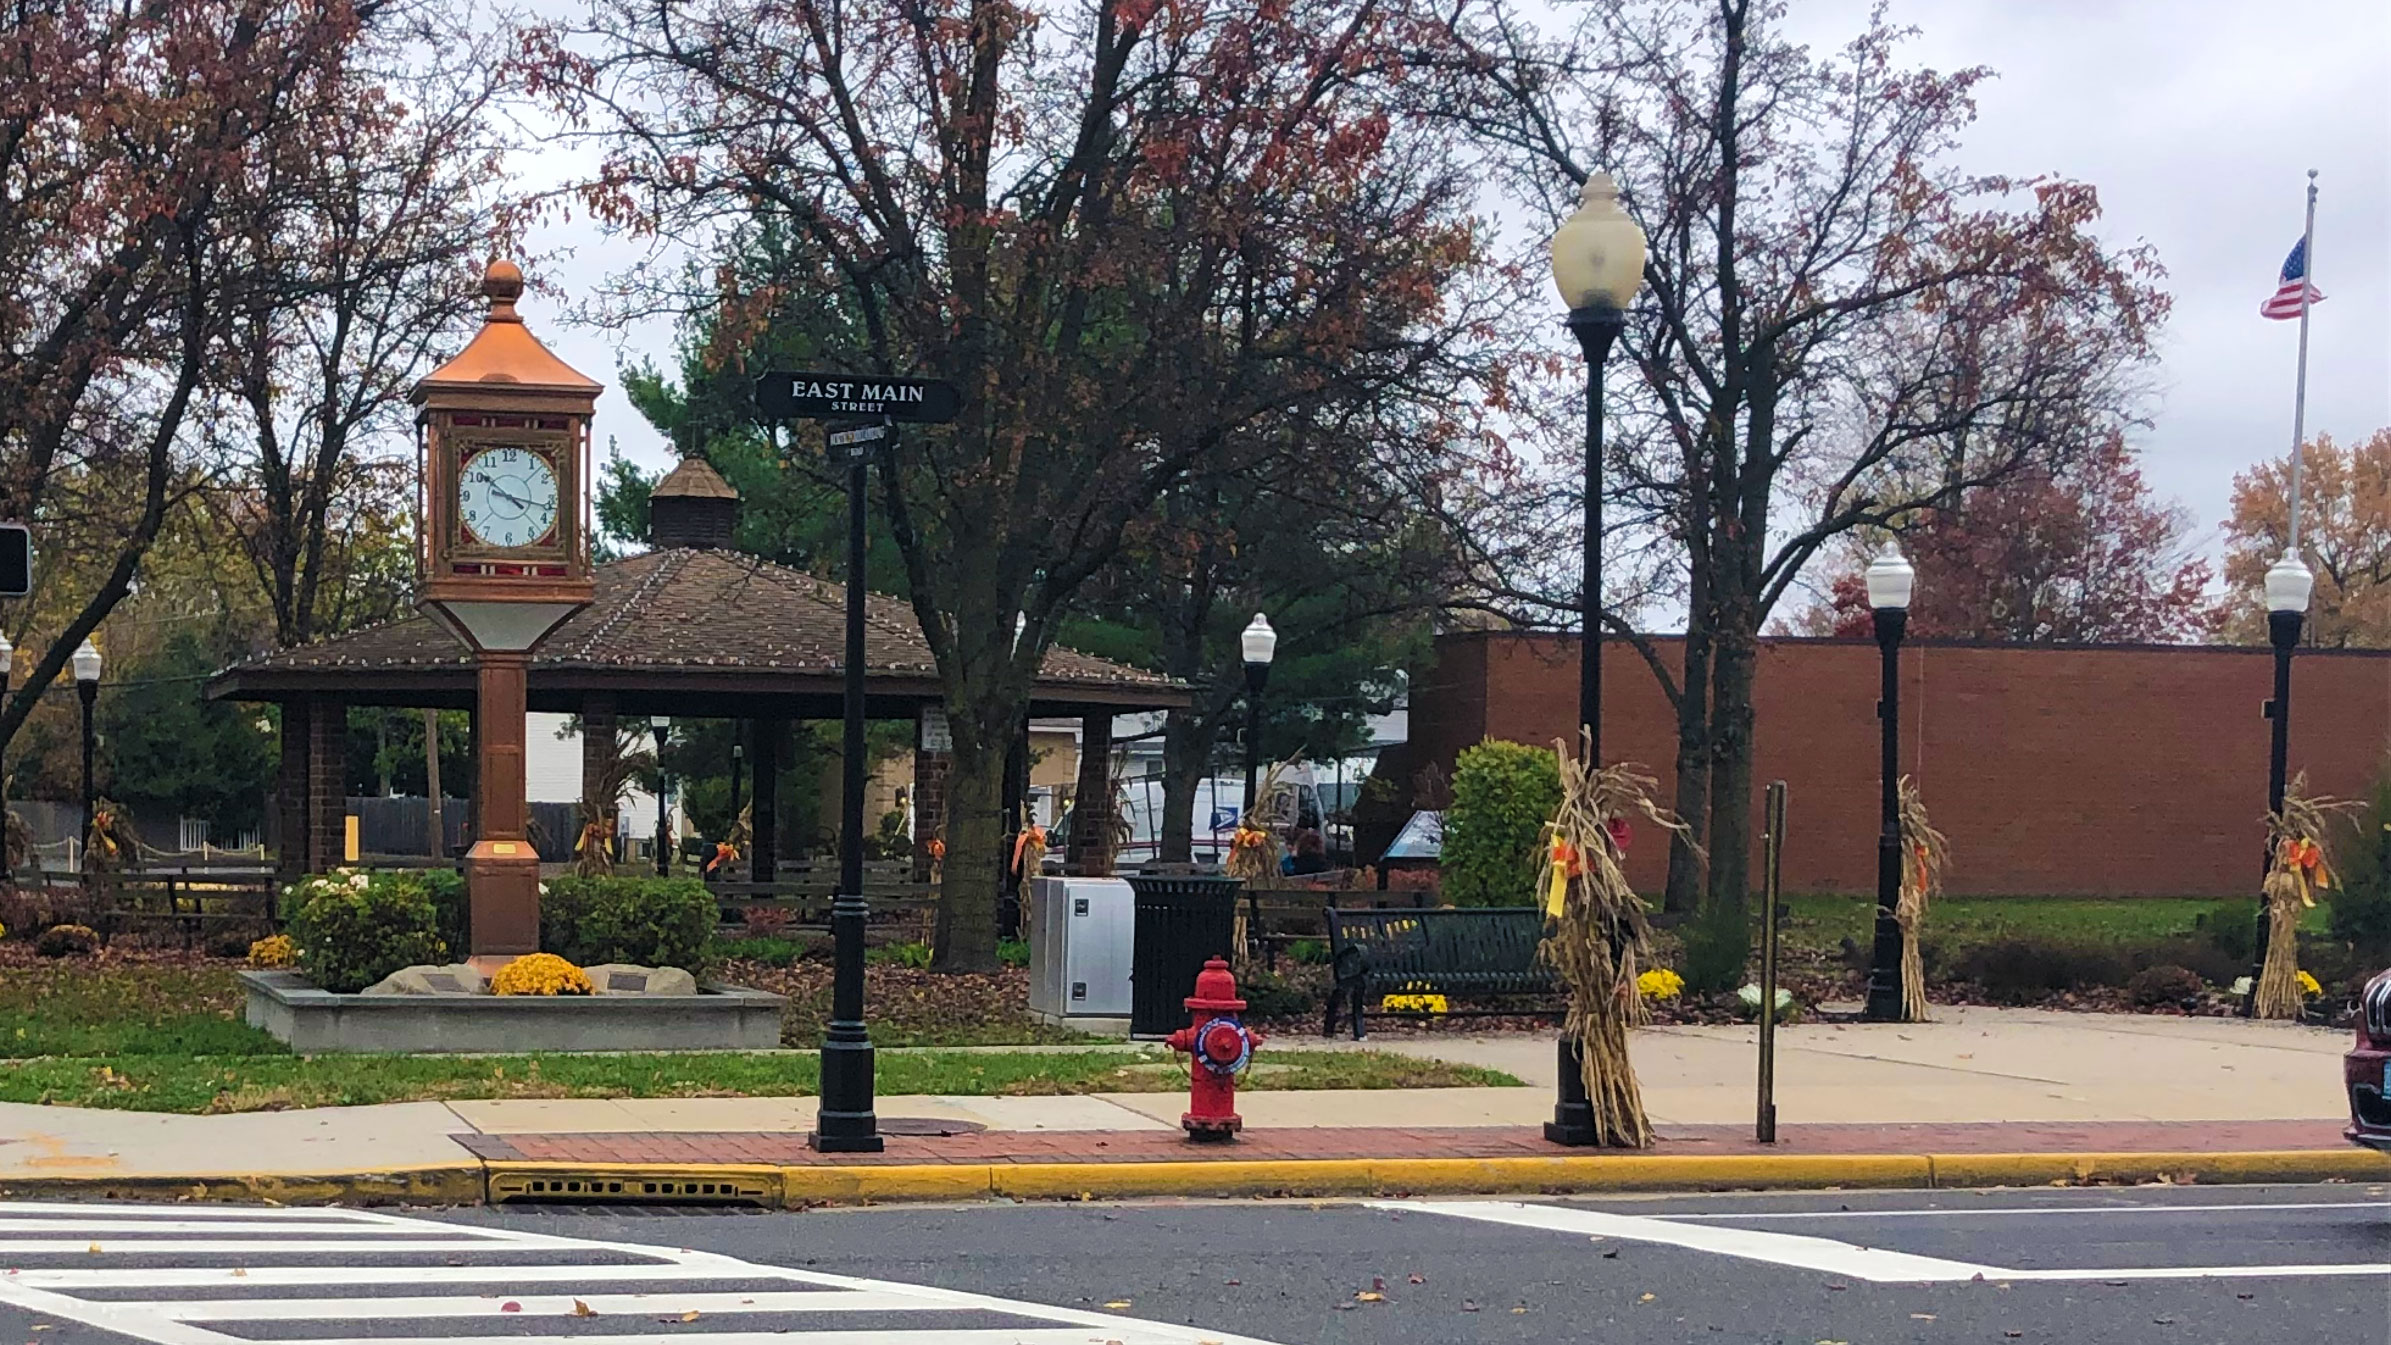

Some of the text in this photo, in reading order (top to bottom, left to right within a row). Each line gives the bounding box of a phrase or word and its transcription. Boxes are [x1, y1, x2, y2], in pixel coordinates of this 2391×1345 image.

[792, 381, 924, 402] EAST MAIN
[831, 401, 884, 412] STREET
[484, 456, 497, 468] 11
[502, 450, 517, 462] 12
[529, 458, 535, 470] 1
[469, 471, 484, 483] 10
[541, 473, 549, 485] 2
[463, 490, 471, 502] 9
[469, 510, 477, 521] 8
[540, 512, 548, 524] 4
[483, 526, 491, 538] 7
[505, 532, 513, 544] 6
[528, 526, 535, 538] 5
